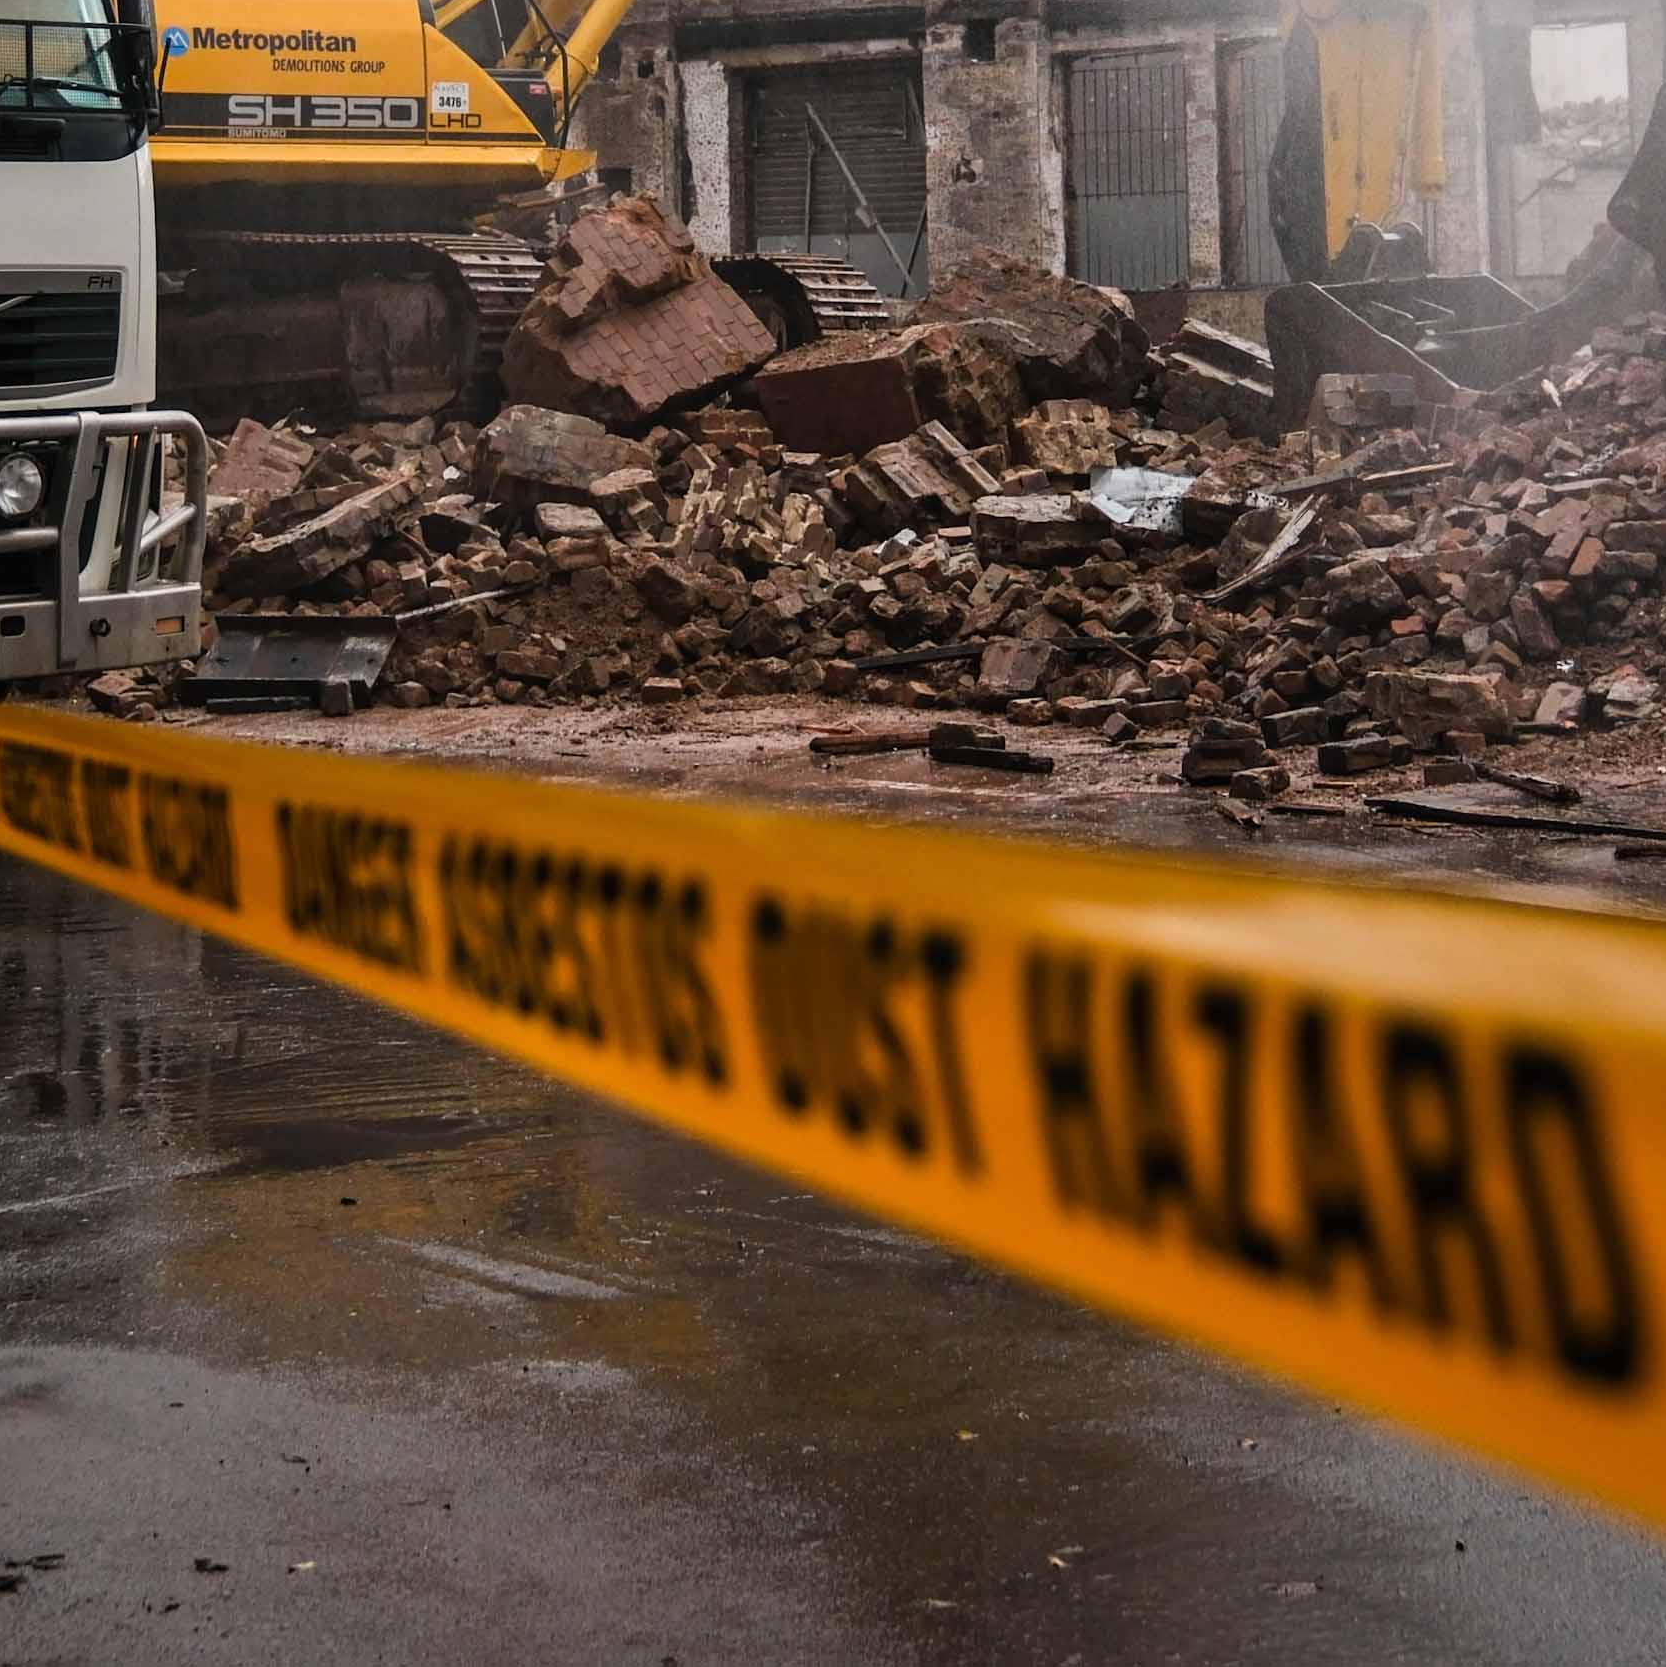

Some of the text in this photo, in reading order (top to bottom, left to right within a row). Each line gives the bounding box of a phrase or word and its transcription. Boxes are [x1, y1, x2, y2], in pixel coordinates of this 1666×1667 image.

[193, 27, 356, 56] Metropolitan
[272, 58, 385, 74] DEMOLITIONS GROUP
[438, 96, 462, 108] 3476
[228, 95, 419, 128] SH 350
[429, 113, 482, 128] LHD
[228, 128, 287, 139] SUMITOMO
[86, 275, 114, 290] FH
[1023, 941, 1655, 1393] HAZARD
